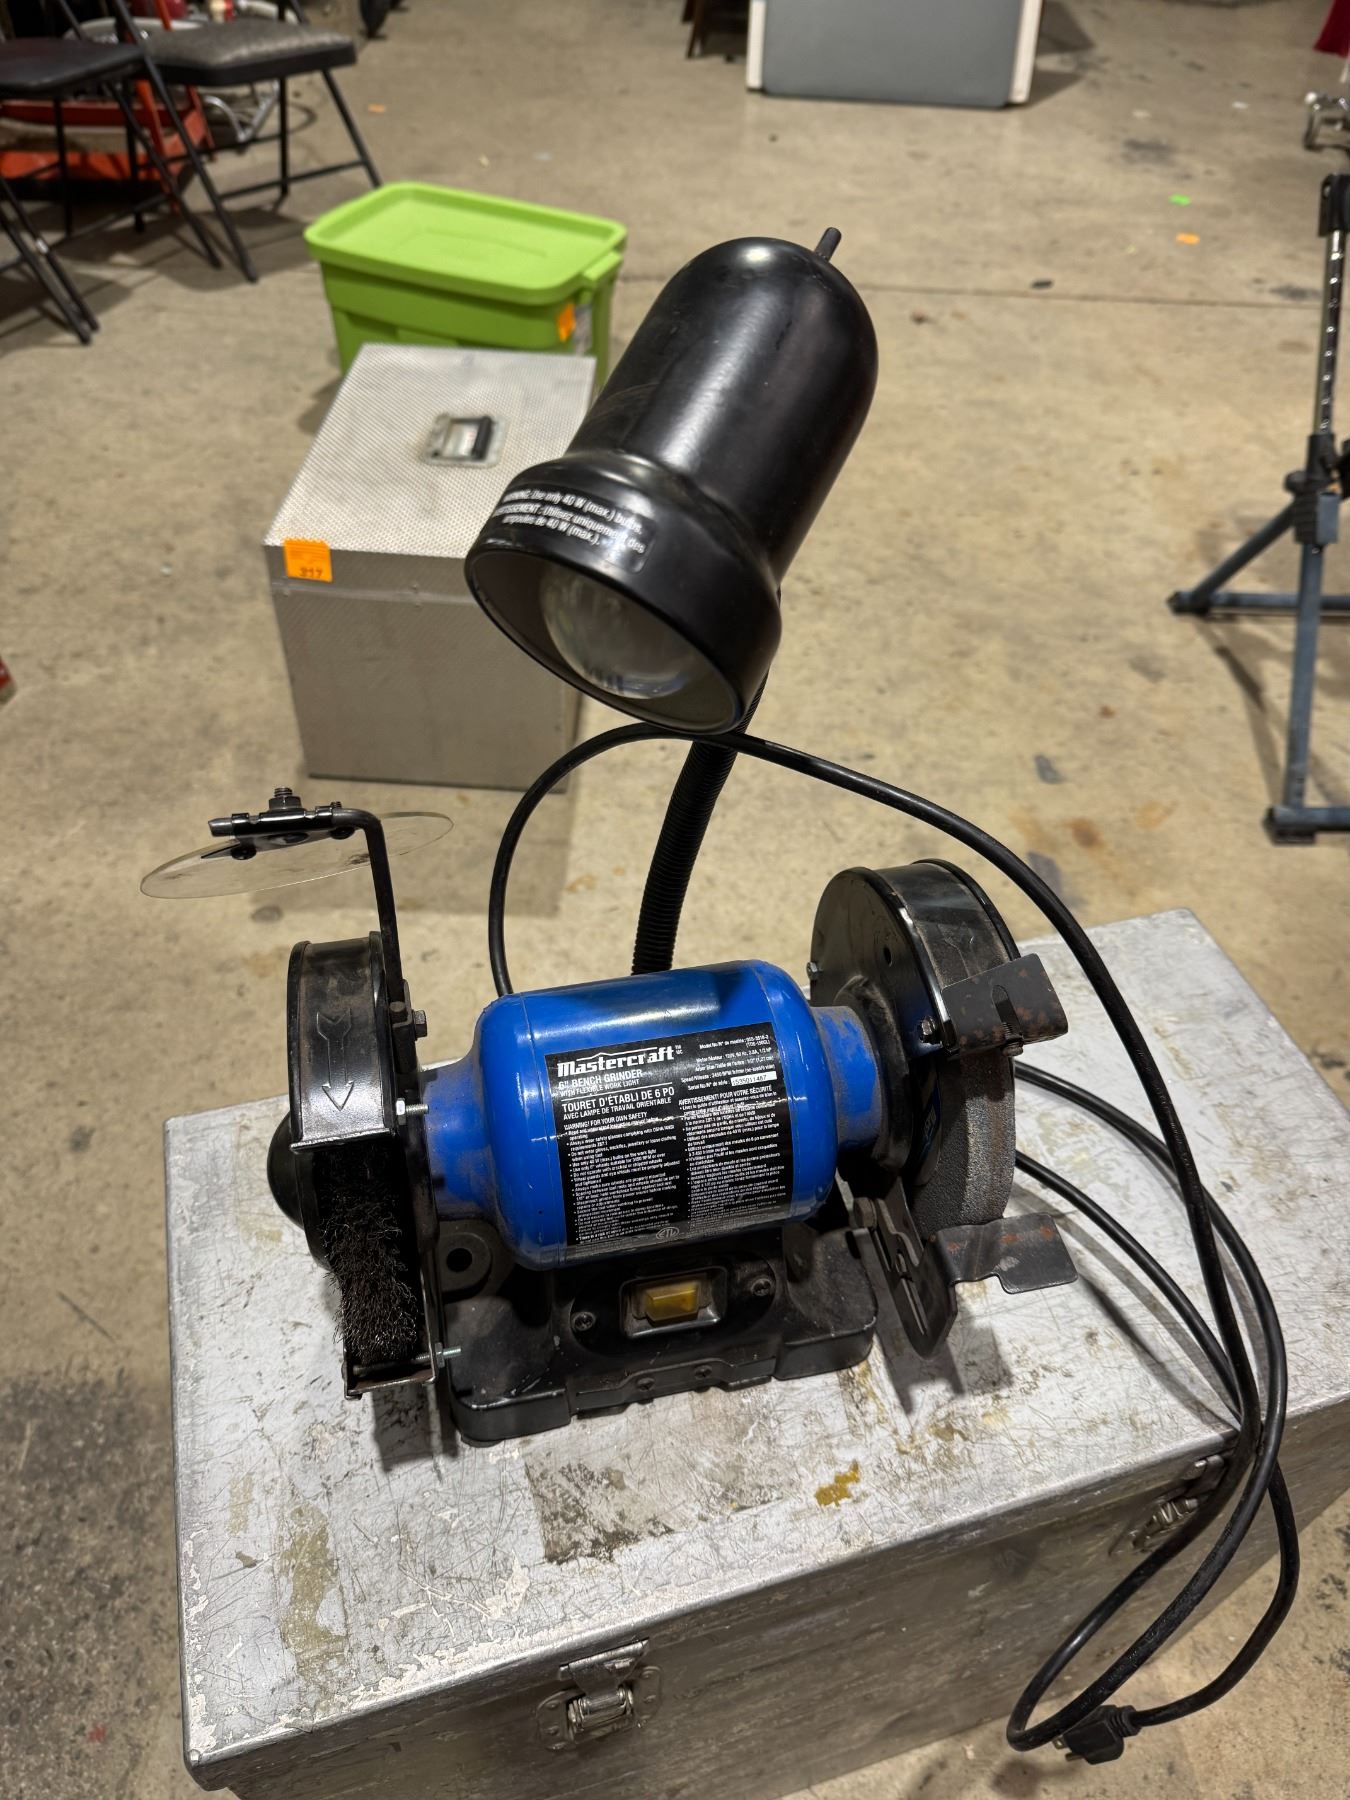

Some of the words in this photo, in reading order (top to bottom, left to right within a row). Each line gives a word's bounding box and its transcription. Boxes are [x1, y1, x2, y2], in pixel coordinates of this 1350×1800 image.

[563, 495, 575, 506] 40
[574, 497, 586, 508] W
[584, 501, 616, 522] (max.)
[546, 518, 558, 530] 40
[557, 521, 569, 532] W
[628, 537, 646, 553] des
[557, 1046, 675, 1078] Mastercraft
[572, 1076, 602, 1088] BENCH
[604, 1069, 643, 1083] GRINDER
[562, 1099, 597, 1113] TOURET
[599, 1092, 639, 1107] D'ÉTABLI
[641, 1090, 653, 1100] DE
[655, 1089, 661, 1098] 6
[663, 1087, 675, 1097] PO
[563, 1112, 579, 1120] AVEC
[580, 1109, 600, 1118] LAMPE
[611, 1103, 635, 1113] TRAVAIL
[636, 1098, 672, 1109] ORIENTABLE
